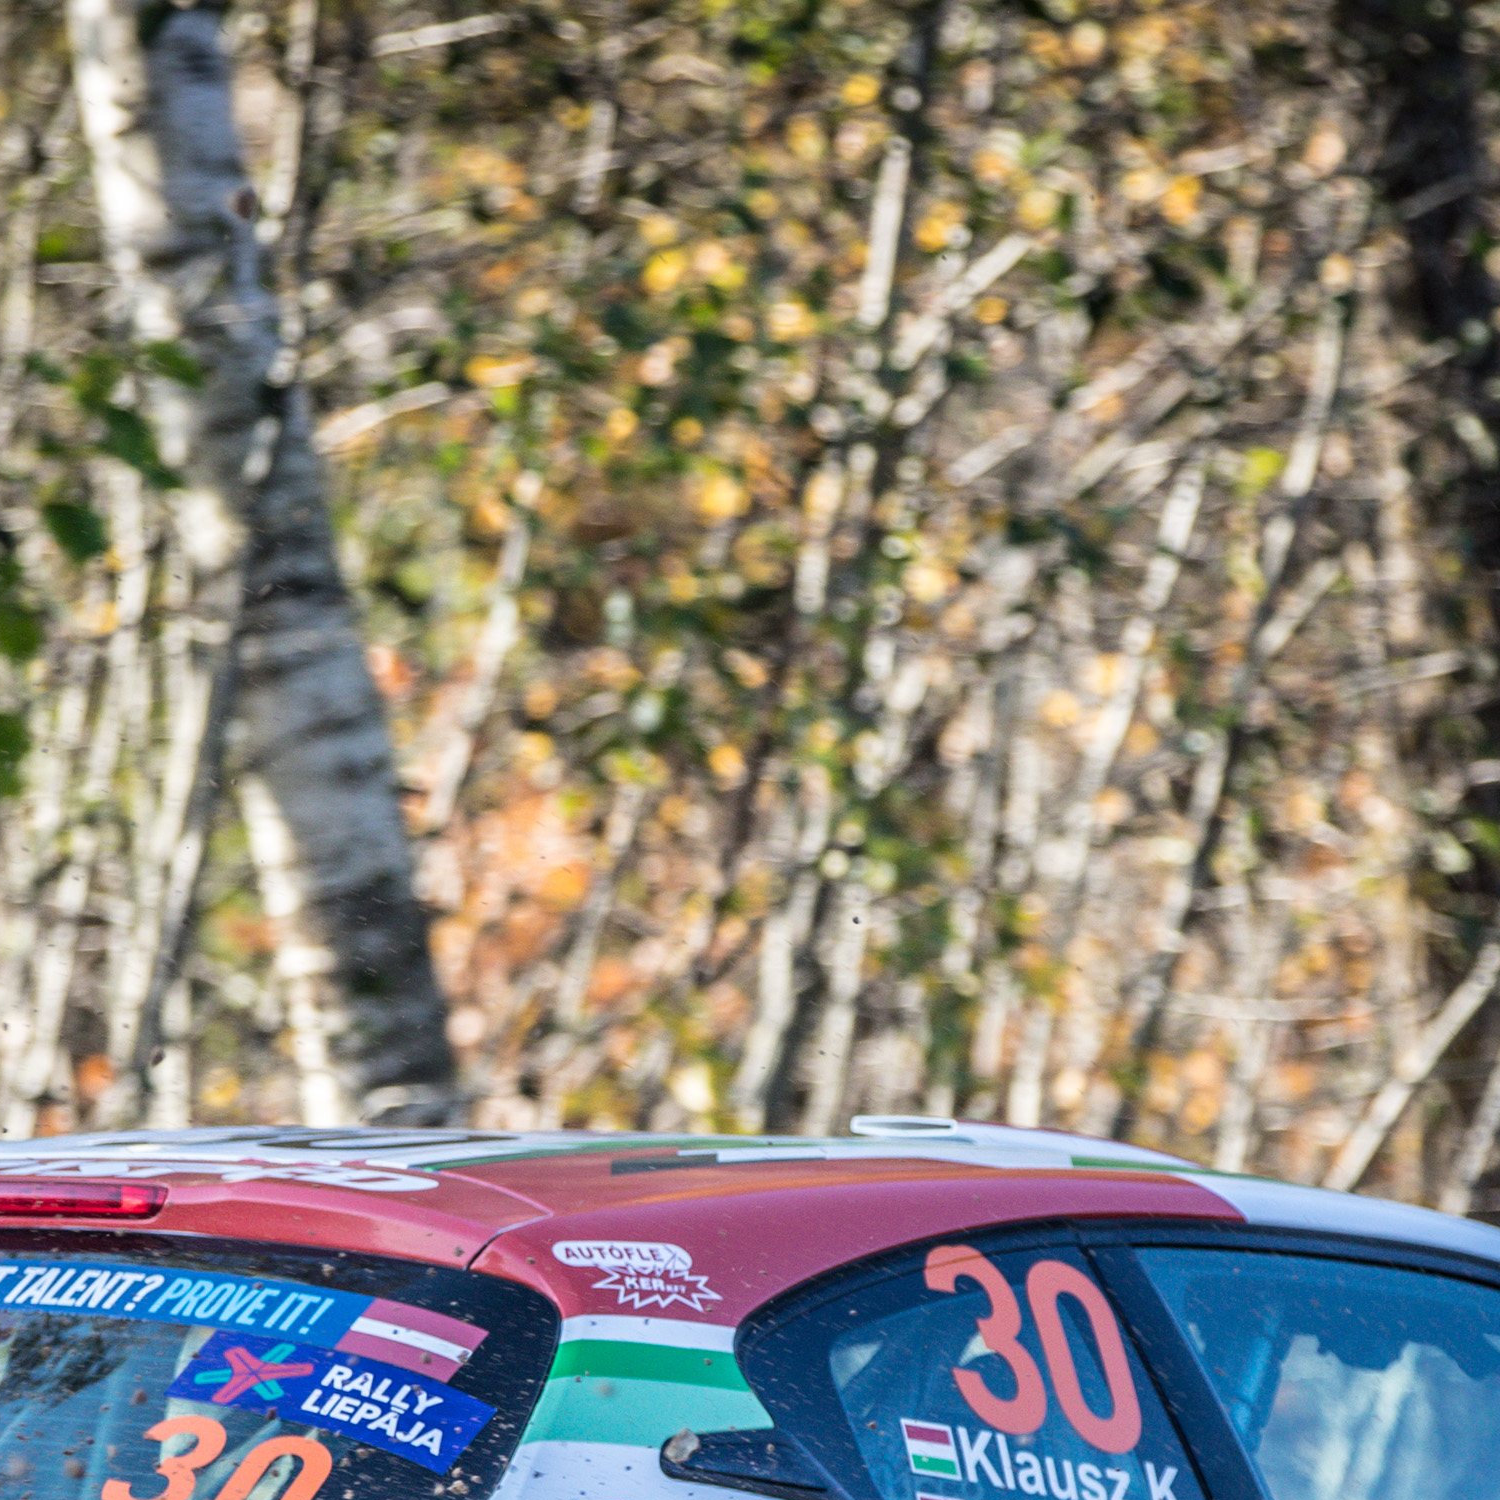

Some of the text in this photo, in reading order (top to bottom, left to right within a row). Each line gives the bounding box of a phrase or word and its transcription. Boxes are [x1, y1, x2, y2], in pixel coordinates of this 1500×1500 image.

[4, 1265, 165, 1312] TALENT?
[148, 1277, 280, 1326] PROVE
[264, 1290, 335, 1335] IT!
[924, 1244, 1143, 1455] 30
[321, 1363, 443, 1416] RALLY
